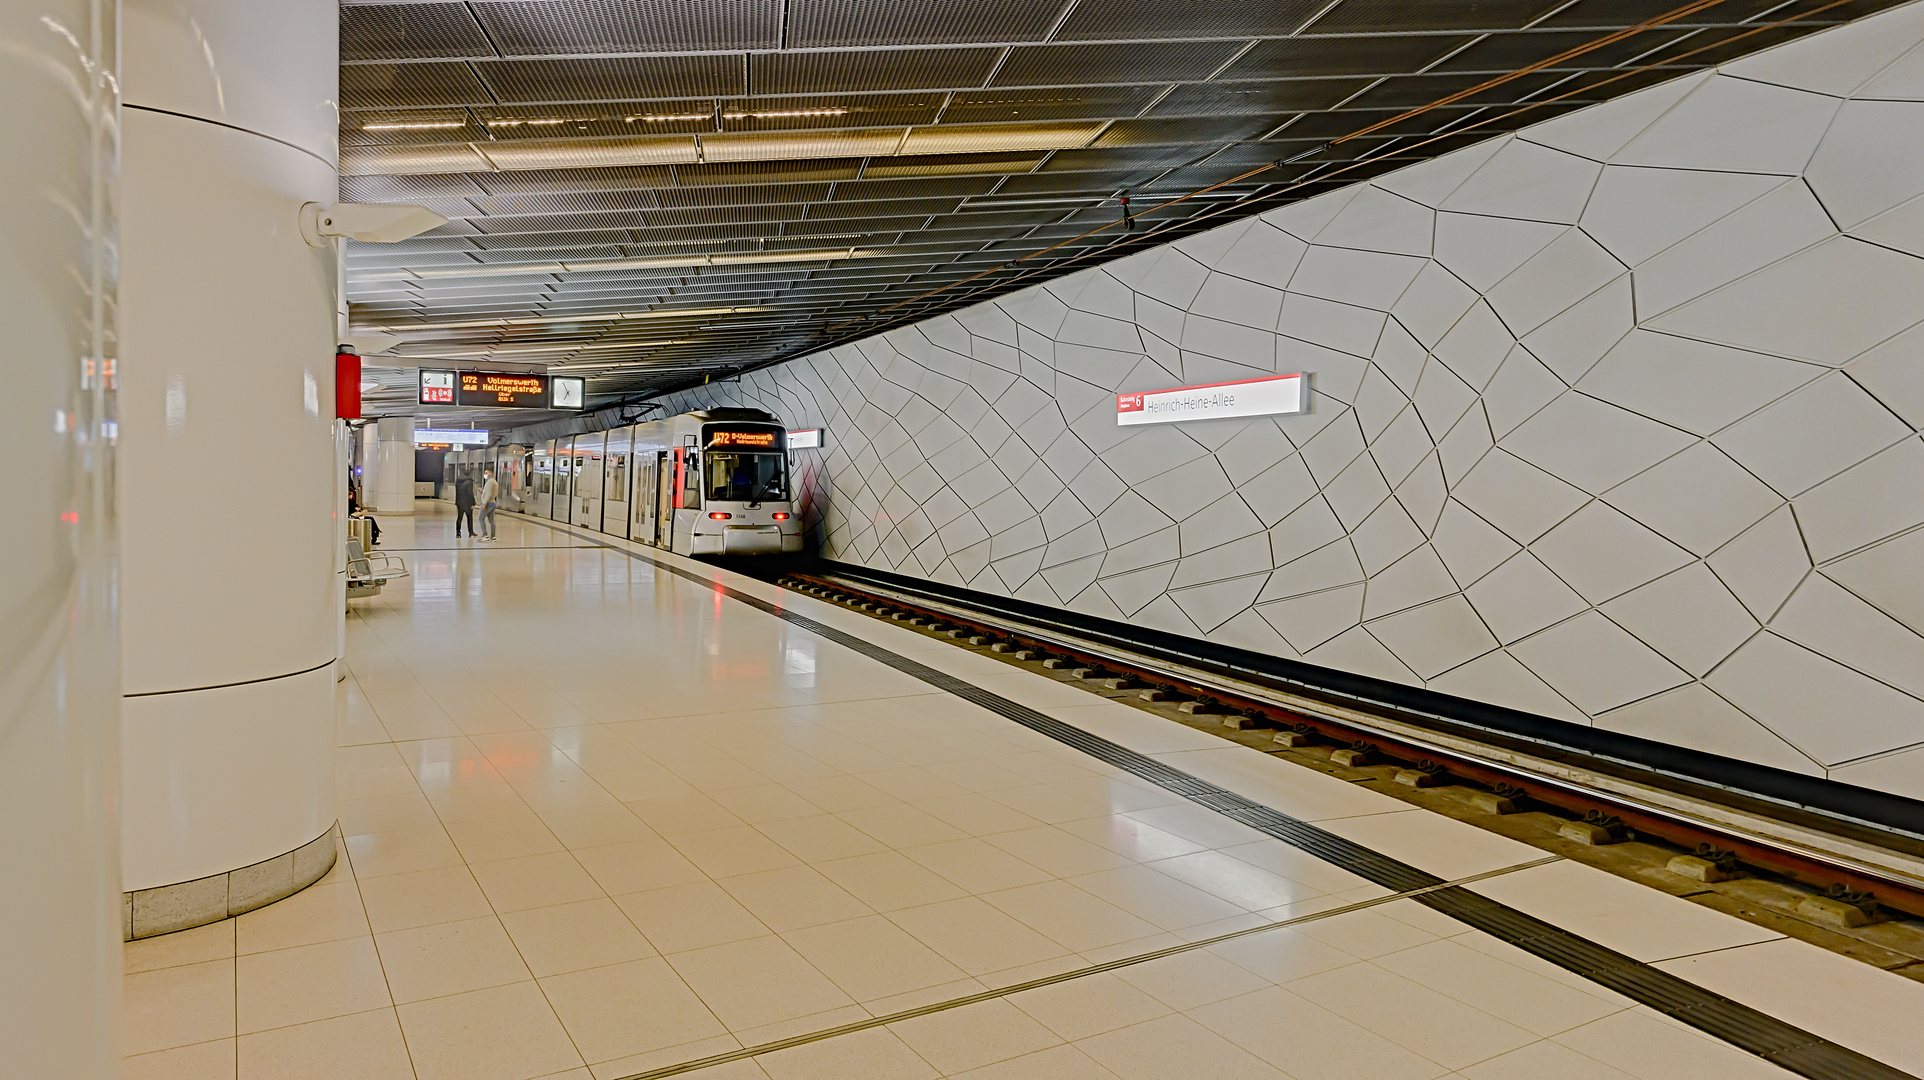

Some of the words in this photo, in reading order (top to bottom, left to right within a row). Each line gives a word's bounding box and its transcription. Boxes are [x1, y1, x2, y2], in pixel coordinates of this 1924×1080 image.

[462, 375, 478, 384] U72
[487, 377, 539, 386] Volmerswerth
[482, 384, 542, 394] Hellriegelstraße
[1136, 395, 1142, 407] 6
[1148, 393, 1235, 413] Heinrich-Heine-Allee
[714, 432, 730, 444] U72
